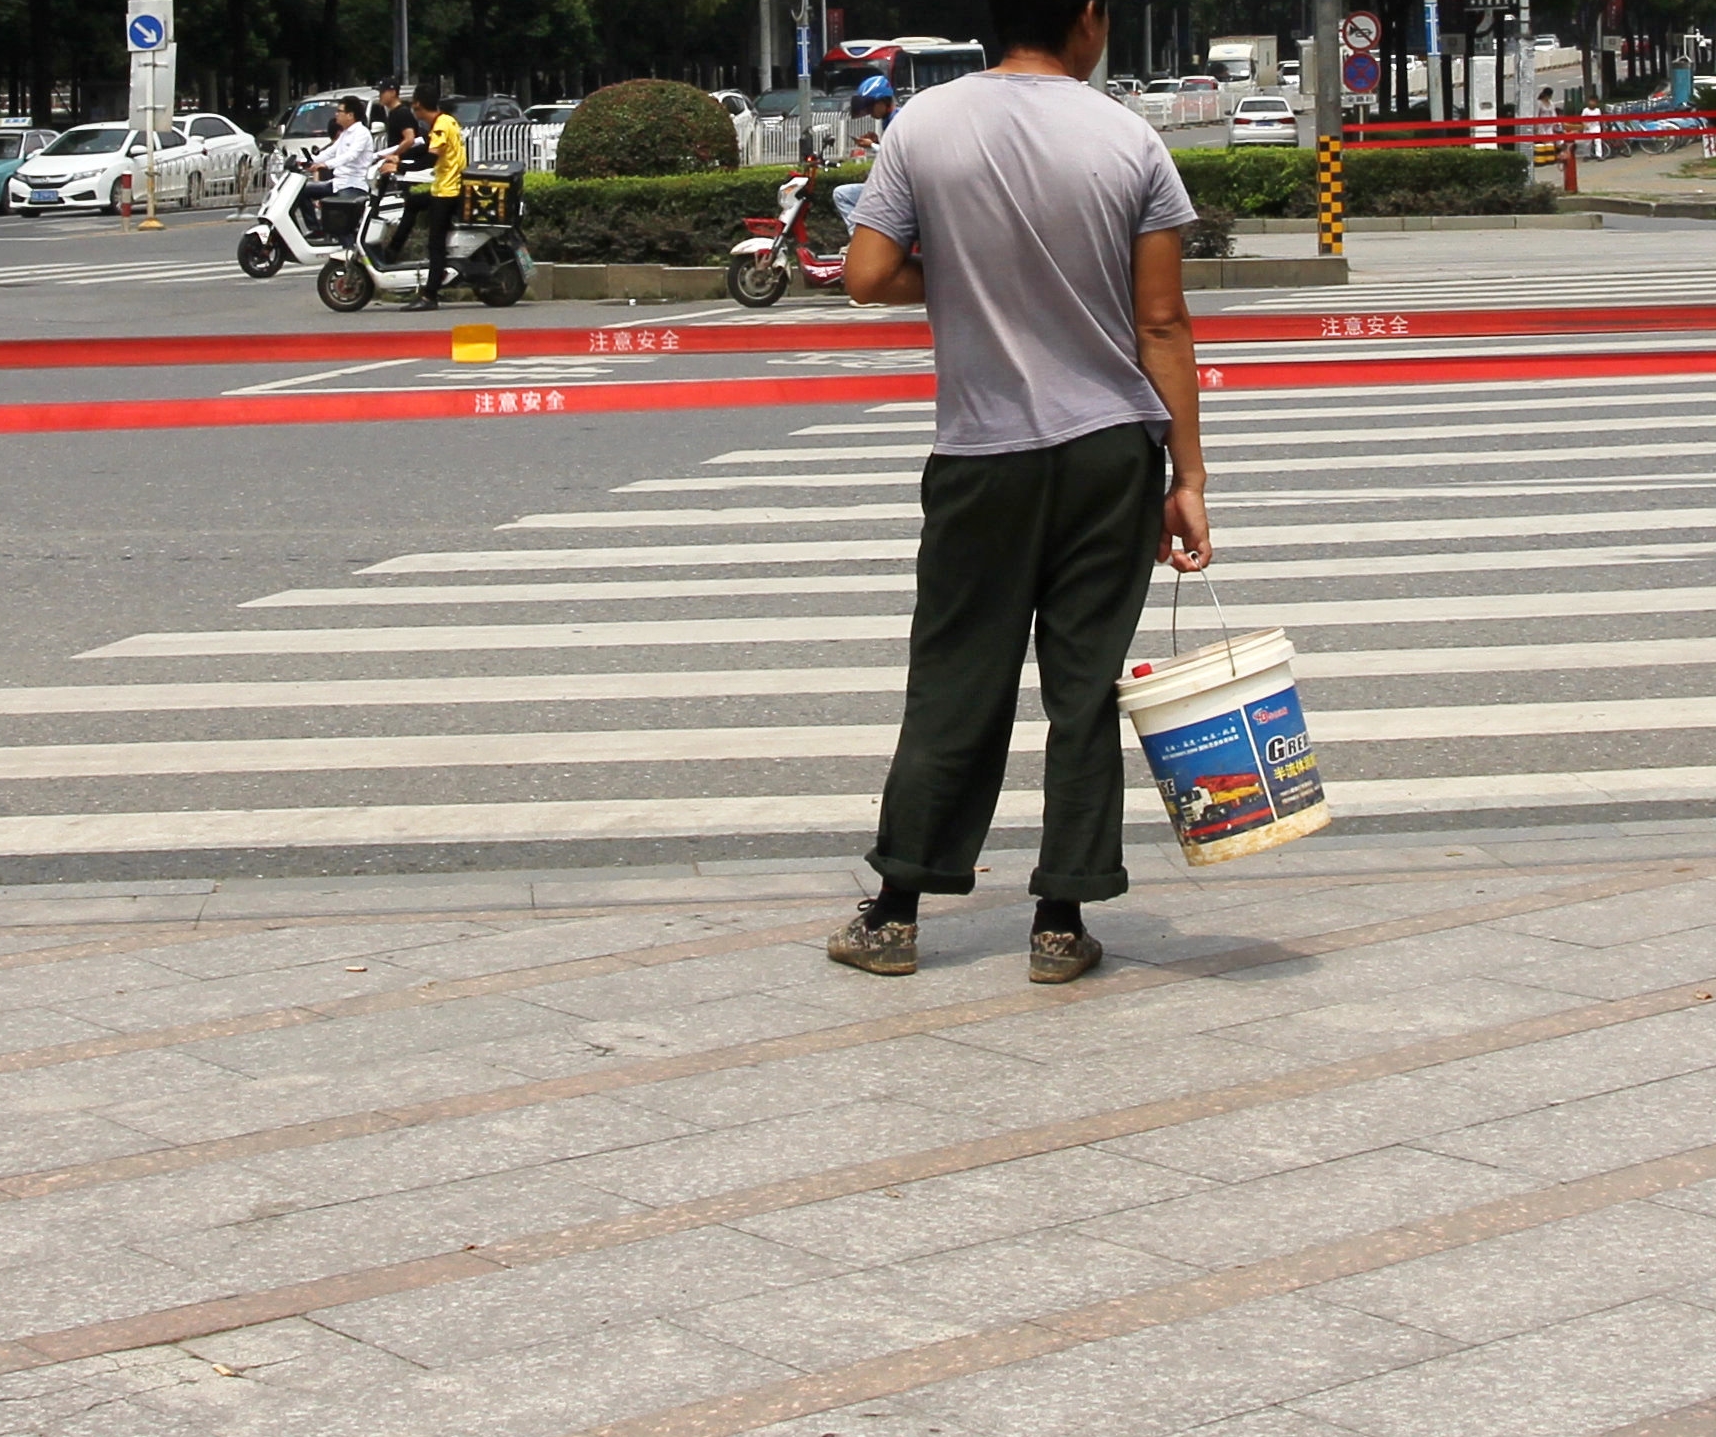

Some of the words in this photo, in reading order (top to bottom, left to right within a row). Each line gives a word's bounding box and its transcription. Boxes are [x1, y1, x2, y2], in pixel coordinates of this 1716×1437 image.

[1321, 315, 1409, 337] 注意安全
[589, 330, 680, 352] 注意安全
[474, 389, 565, 413] 注意安全
